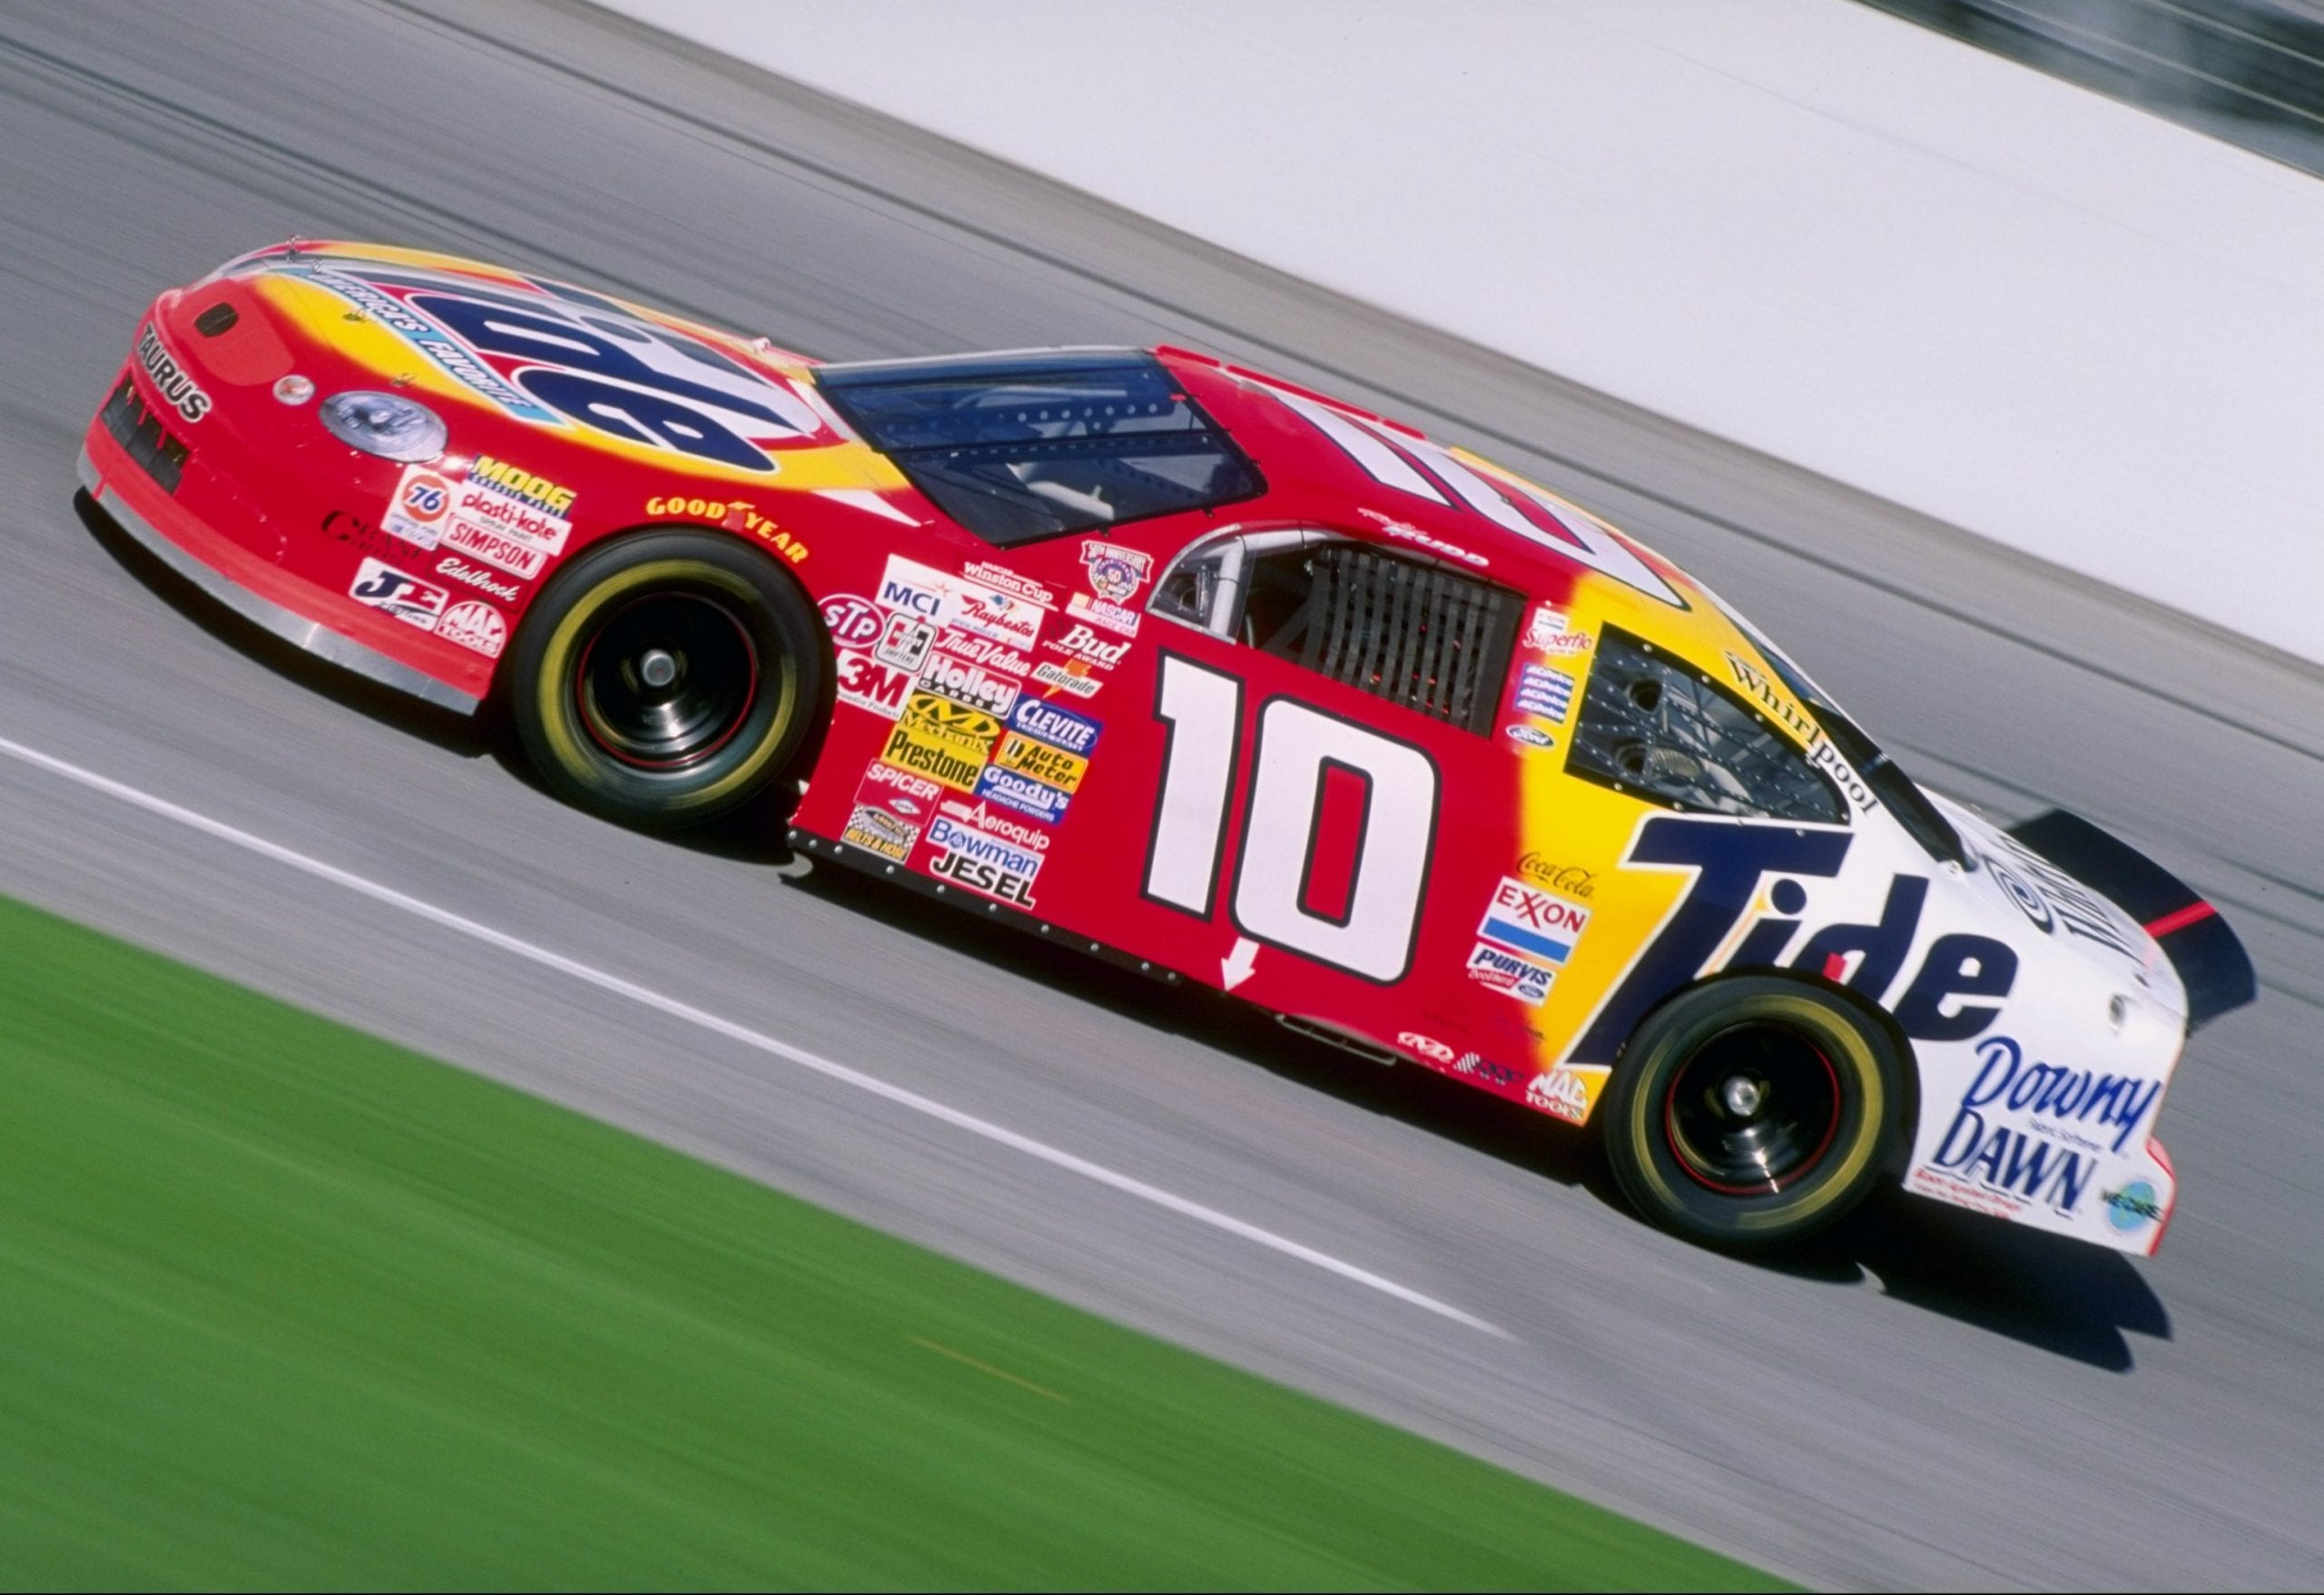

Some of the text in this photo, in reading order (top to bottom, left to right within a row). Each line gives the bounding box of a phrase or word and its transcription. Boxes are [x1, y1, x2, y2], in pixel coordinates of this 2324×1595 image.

[137, 321, 212, 422] TAURUS
[419, 339, 534, 410] FAVORITE
[408, 486, 442, 511] 76
[472, 456, 577, 512] MOOG
[461, 491, 558, 540] plasti-kote
[450, 522, 536, 570] SIMPSON
[355, 570, 447, 616] JE
[435, 557, 520, 602] Edelbrock
[883, 581, 941, 616] MCI
[964, 562, 1053, 603] Winston Cup
[446, 603, 502, 634] MAC
[824, 602, 876, 639] STP
[960, 594, 1035, 636] Raybestos
[1090, 599, 1135, 623] NASCAR
[1096, 616, 1118, 629] RACE
[438, 625, 500, 655] TOOLS
[1042, 640, 1073, 655] POLE
[1073, 653, 1115, 671] AWARD
[1059, 624, 1132, 664] Bud
[1523, 628, 1591, 650] Superflo
[838, 658, 910, 709] 3M
[925, 655, 1016, 713] Holley
[1037, 664, 1095, 694] Gatorade
[1017, 699, 1094, 745] CLEVITE
[1512, 727, 1550, 745] Ford
[1725, 652, 1876, 816] Whirlpool
[887, 729, 979, 787] Prestone
[1018, 759, 1077, 785] Meter
[1026, 745, 1074, 770] Auto
[866, 763, 940, 801] SPICER
[984, 766, 1069, 810] Goody's
[964, 801, 1050, 851] Aeroquip
[982, 789, 1055, 822] HEADACHE POWDERS
[1140, 648, 1441, 986] 10
[929, 820, 1039, 877] Bowman
[932, 852, 1033, 907] JESEL
[1497, 884, 1585, 932] EXXON
[1571, 817, 2017, 1064] Tide
[1474, 950, 1551, 985] PURVIS
[1526, 1089, 1584, 1119] TOOLS
[1528, 1068, 1587, 1105] MAC
[1962, 1036, 2163, 1153] Downy
[1932, 1107, 2099, 1211] DAWN
